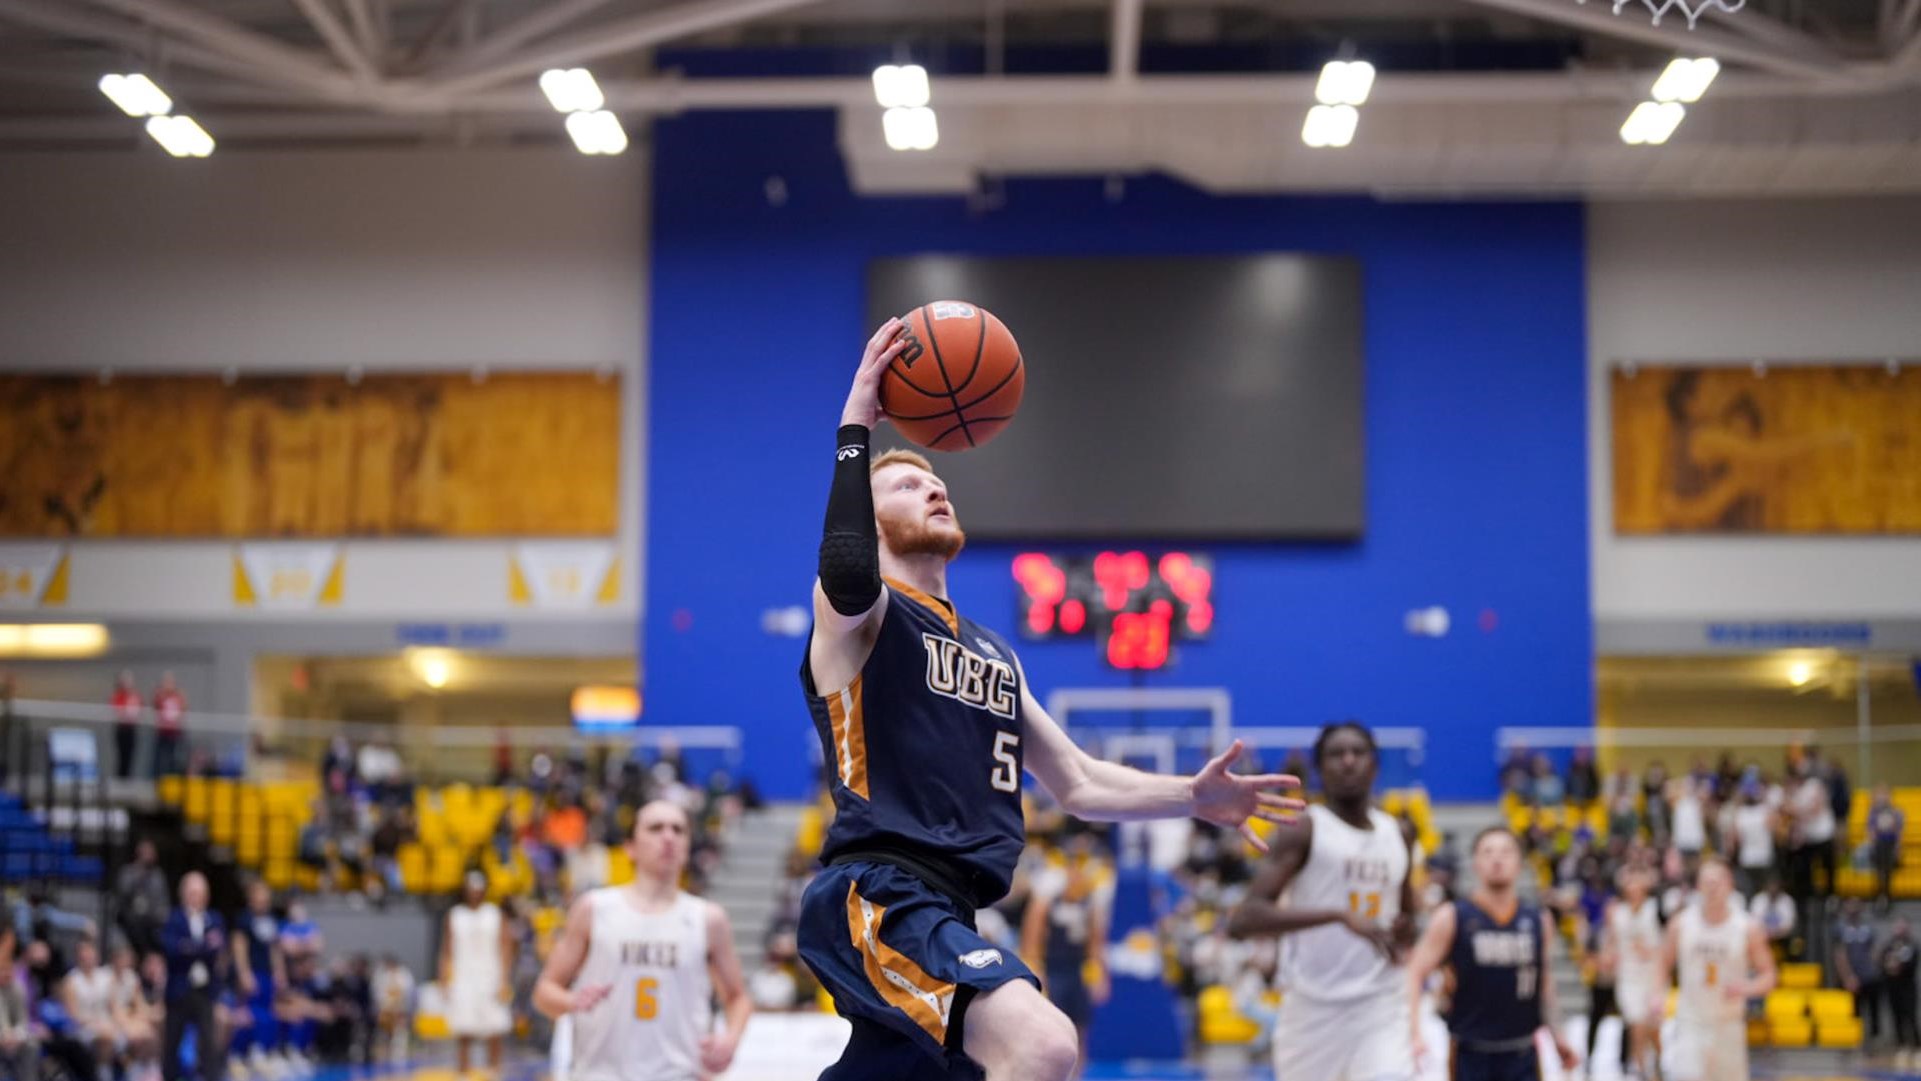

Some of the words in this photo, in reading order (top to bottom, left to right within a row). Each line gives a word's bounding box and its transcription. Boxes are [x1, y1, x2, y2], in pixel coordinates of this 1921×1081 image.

[922, 632, 1016, 720] UBC
[991, 730, 1019, 793] 5
[634, 976, 658, 1021] 6
